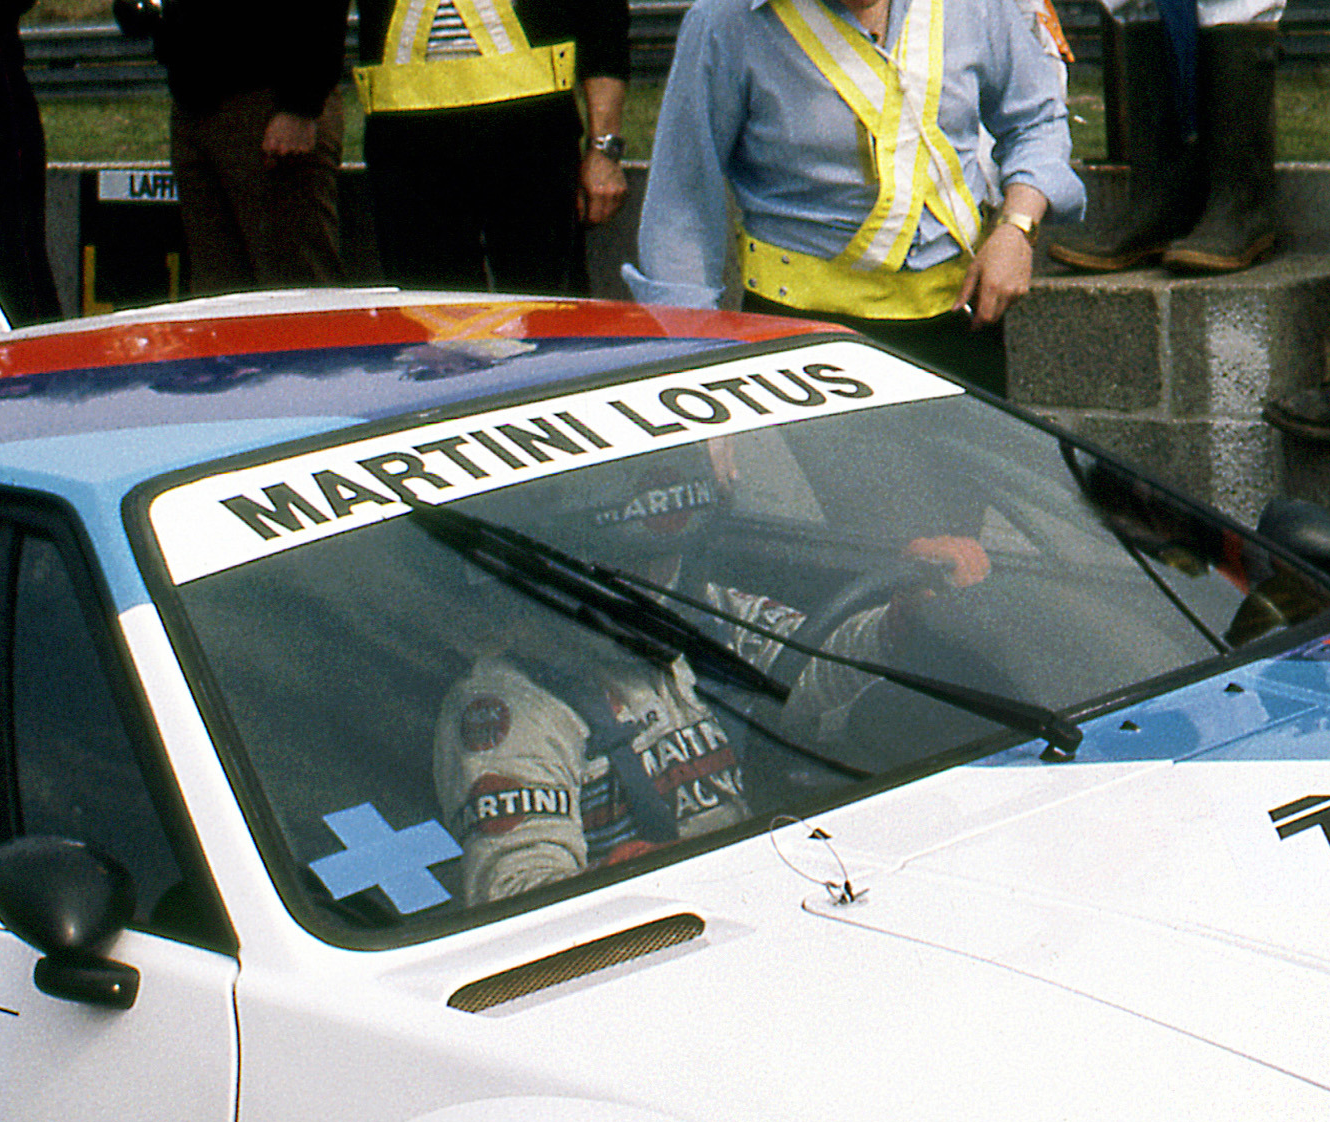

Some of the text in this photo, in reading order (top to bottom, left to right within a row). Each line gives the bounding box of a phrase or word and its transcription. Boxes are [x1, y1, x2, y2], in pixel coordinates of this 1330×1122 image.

[219, 363, 875, 541] MARTINI LOTUS
[466, 788, 568, 819] RTINI
